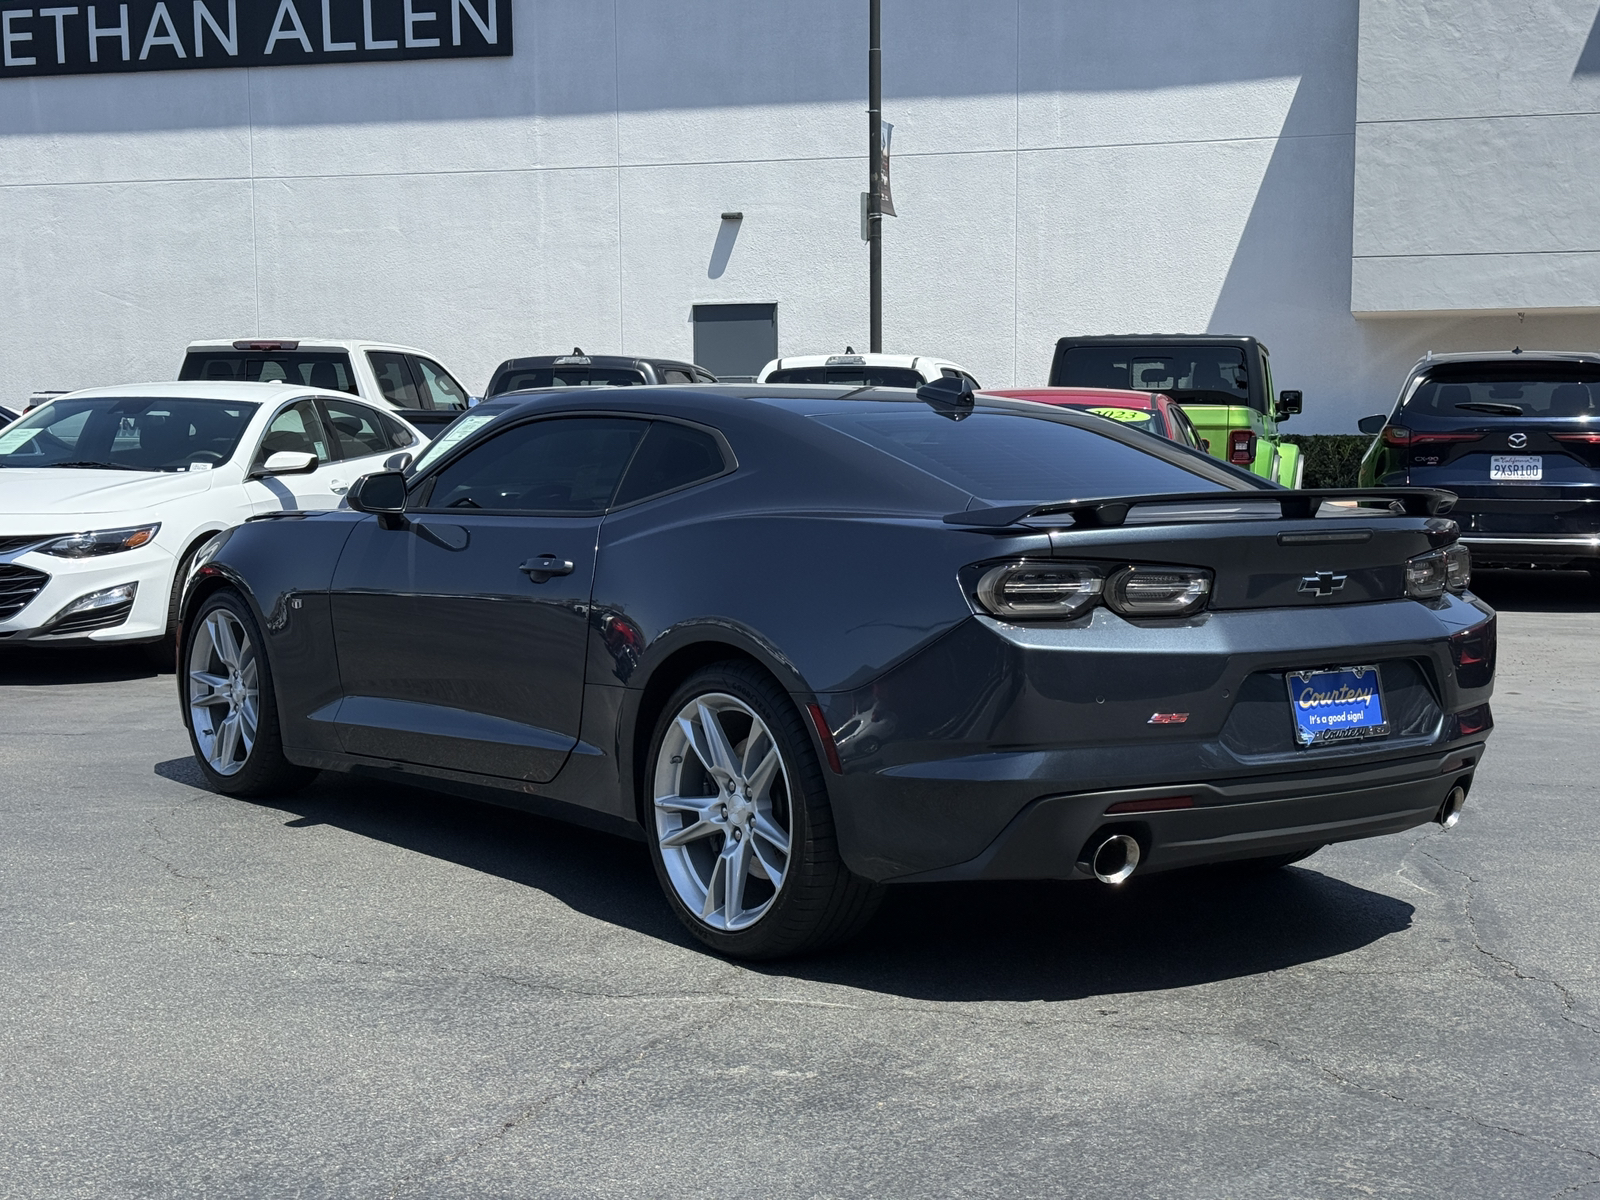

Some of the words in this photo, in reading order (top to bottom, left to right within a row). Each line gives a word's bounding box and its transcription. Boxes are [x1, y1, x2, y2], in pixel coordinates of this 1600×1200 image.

[1, 0, 239, 67] ETHAN
[263, 0, 498, 55] ALLEN
[1500, 456, 1532, 464] California
[1494, 464, 1539, 477] 9XSR100
[731, 682, 772, 719] GOODYEAR
[1299, 684, 1373, 709] Courtesy
[1309, 714, 1321, 725] It's
[1328, 711, 1346, 726] good
[1347, 710, 1364, 723] sign!
